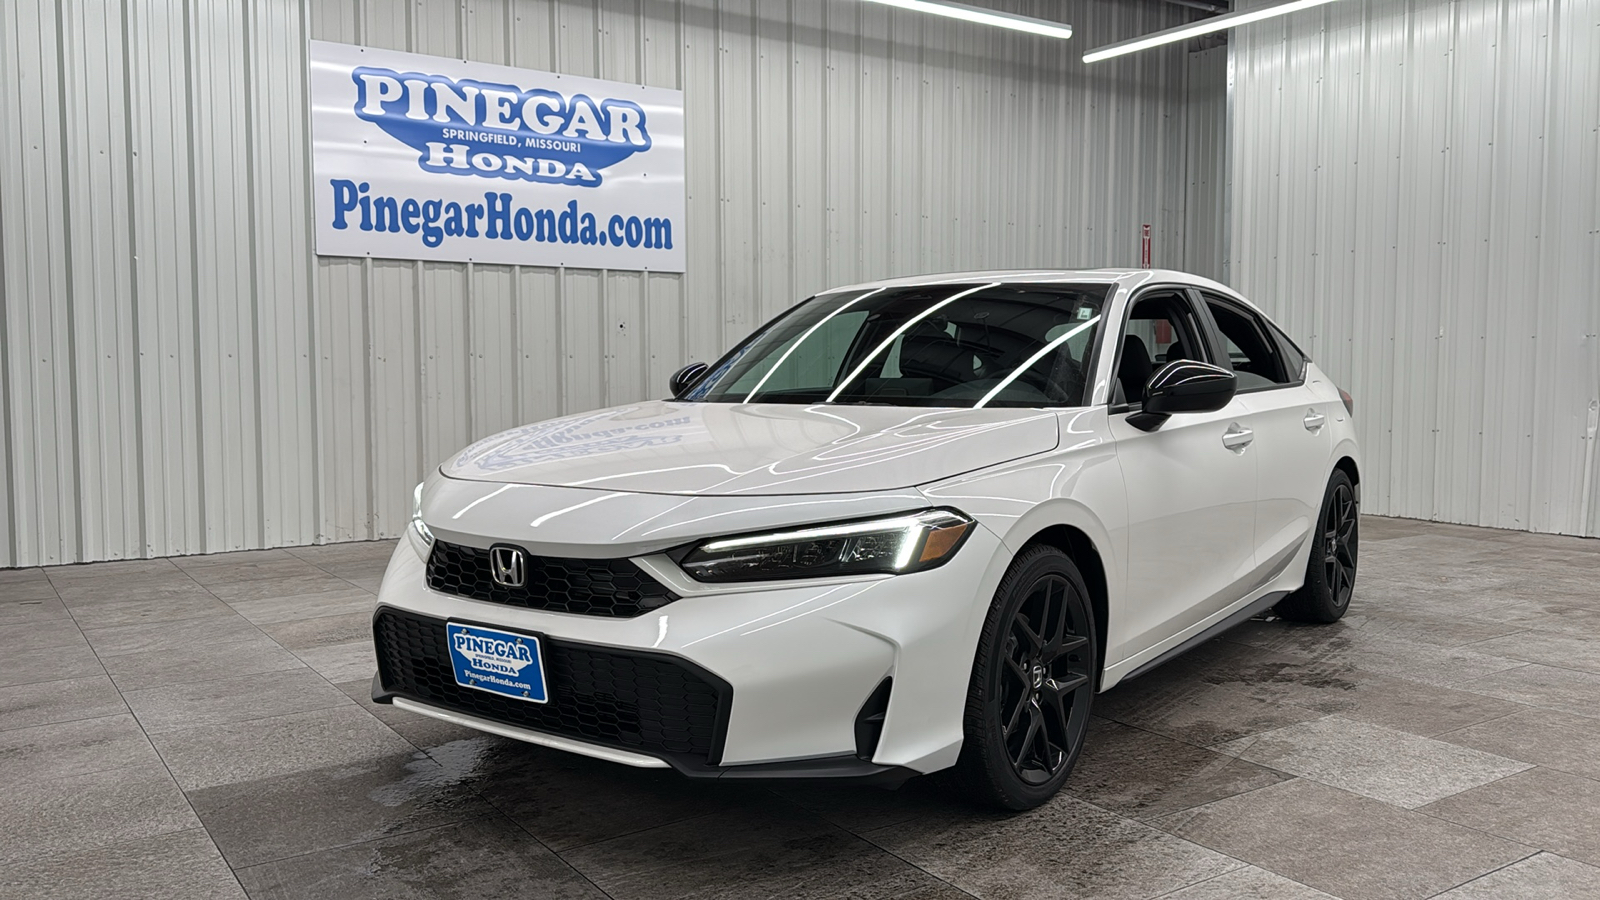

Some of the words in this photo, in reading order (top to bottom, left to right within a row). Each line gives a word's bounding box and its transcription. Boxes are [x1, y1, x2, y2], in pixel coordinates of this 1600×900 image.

[358, 73, 647, 146] PINEGAR
[442, 127, 522, 148] SPRINGFIELD,
[525, 137, 582, 153] MISSOURI
[424, 141, 597, 181] HONDA
[330, 178, 673, 250] PinegarHonda.com
[455, 635, 531, 662] PINEGAR
[464, 669, 532, 690] PinegarHonda.com
[472, 658, 518, 675] HONDA
